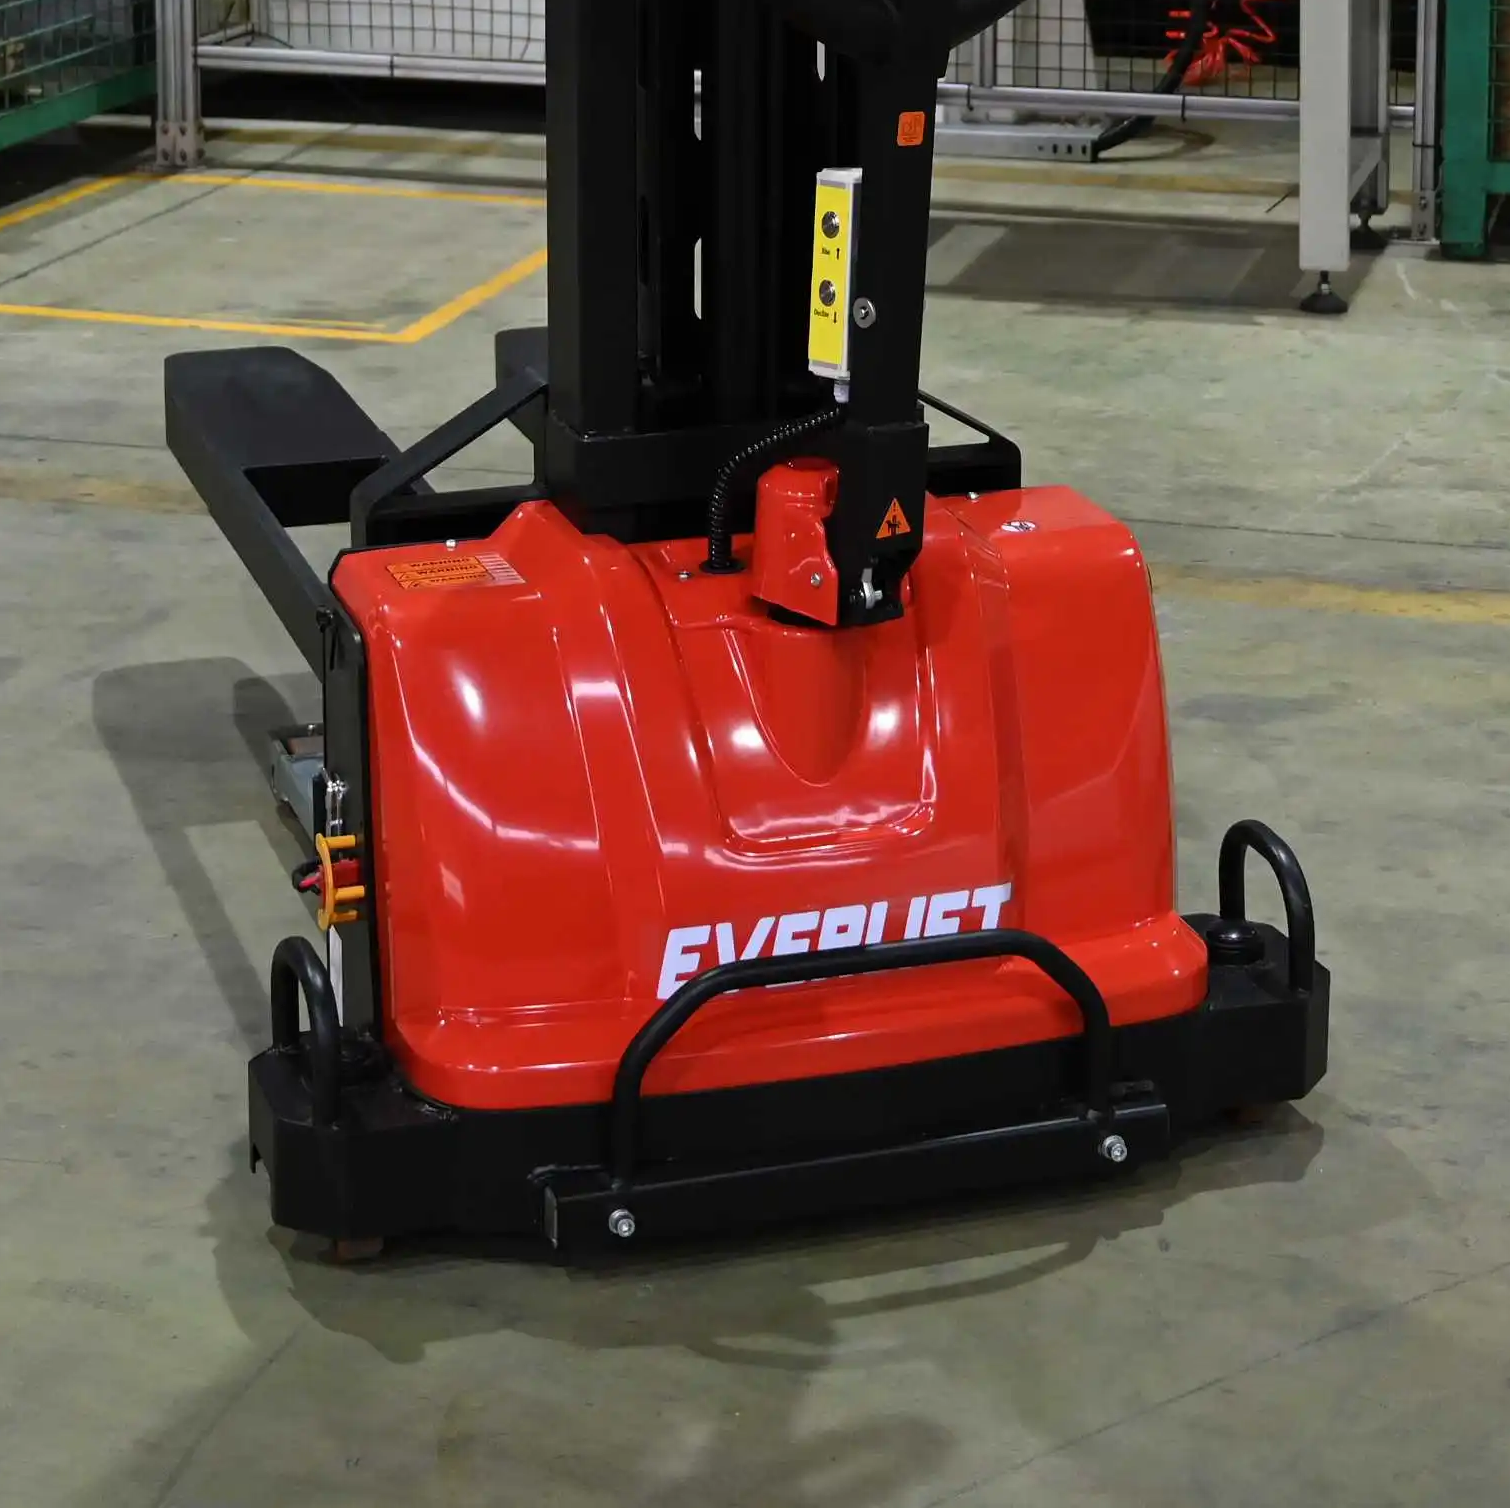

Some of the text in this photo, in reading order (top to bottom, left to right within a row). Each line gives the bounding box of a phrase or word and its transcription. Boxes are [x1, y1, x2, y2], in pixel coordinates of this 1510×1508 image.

[410, 558, 471, 568] WARNING
[417, 565, 479, 575] WARNING
[656, 882, 1013, 1000] EVERLIFT
